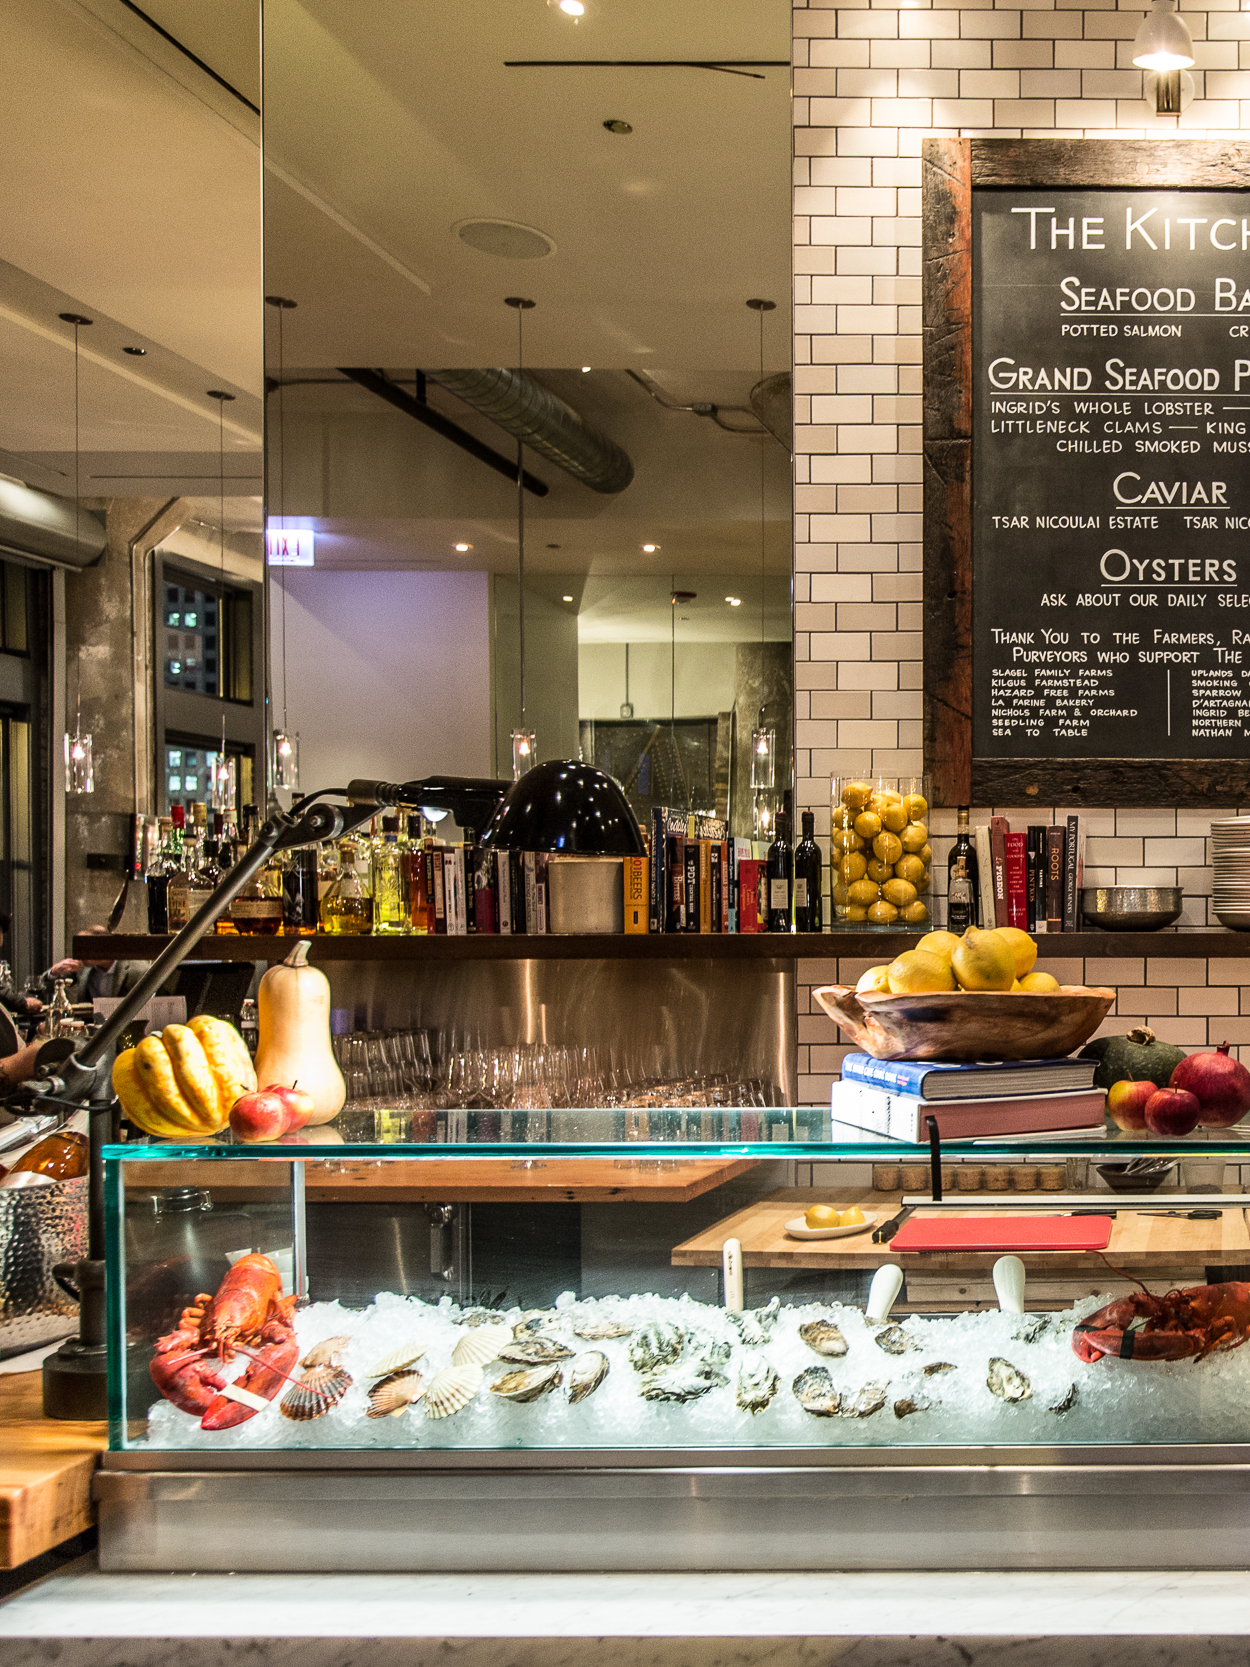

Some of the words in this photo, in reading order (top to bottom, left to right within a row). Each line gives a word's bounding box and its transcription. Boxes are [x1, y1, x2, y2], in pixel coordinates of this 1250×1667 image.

[1010, 207, 1106, 250] THE
[1059, 276, 1196, 312] SEAFOOD
[1061, 324, 1119, 337] POTTED
[1123, 324, 1182, 338] SALMON
[987, 357, 1093, 391] GRAND
[1104, 357, 1220, 391] SEAFOOD
[991, 399, 1061, 415] INGRID'S
[1073, 401, 1132, 416] WHOLE
[1144, 401, 1215, 416] LOBSTER
[991, 419, 1091, 434] LITTLENECK
[1103, 420, 1163, 435] CLAMS
[1206, 421, 1247, 435] KING
[1056, 439, 1123, 454] CHILLED
[1134, 439, 1201, 454] SMOKED
[1112, 471, 1228, 505] CAVIAR
[991, 515, 1030, 529] TSAR
[1035, 515, 1100, 529] NICOULAI
[1108, 515, 1159, 530] ESTATE
[1183, 515, 1219, 530] TSAR
[1099, 548, 1237, 582] OYSTERS
[1040, 593, 1068, 607] ASK
[1075, 593, 1122, 607] ABOUT
[1128, 593, 1159, 607] OUR
[1167, 593, 1207, 608] DAILY
[990, 628, 1035, 645] THANK
[1040, 627, 1070, 645] YOU
[1080, 632, 1101, 645] TO
[1112, 632, 1140, 645] THE
[1153, 628, 1222, 648] FARMERS,
[1012, 646, 1088, 664] PURVEYORS
[1096, 651, 1130, 664] WHO
[1137, 650, 1201, 664] SUPPORT
[1212, 647, 1243, 664] THE
[991, 668, 1028, 677] SLAGEL
[1034, 668, 1071, 677] FAMILY
[1078, 668, 1114, 677] FARMS
[1191, 669, 1234, 678] UPLANDS
[991, 678, 1027, 688] KILGUS
[1034, 678, 1099, 687] FARMSTEAD
[1191, 679, 1238, 688] SMOKING
[991, 688, 1035, 697] HAZARD
[1043, 688, 1070, 697] FREE
[1078, 689, 1115, 697] FARMS
[1191, 688, 1242, 698] SPARROW
[991, 698, 1005, 707] LA
[1012, 698, 1046, 707] FARINE
[1055, 698, 1095, 707] BAKERY
[991, 707, 1031, 717] NICHOLS
[1039, 708, 1067, 717] FARM
[1073, 707, 1083, 717] &
[1089, 708, 1138, 717] ORCHARD
[1192, 708, 1228, 718] INGRID
[991, 718, 1045, 727] SEEDLING
[1058, 718, 1090, 728] FARM
[1191, 718, 1242, 728] NORTHERN
[991, 727, 1012, 737] SEA
[1025, 728, 1041, 737] TO
[1052, 728, 1088, 737] TABLE
[1191, 728, 1233, 738] NATHAN
[1069, 821, 1076, 832] MY
[1067, 833, 1076, 870] PORTUGAL
[1051, 848, 1060, 881] ROOTS
[687, 866, 696, 885] PDT
[996, 865, 1004, 900] PIGEON
